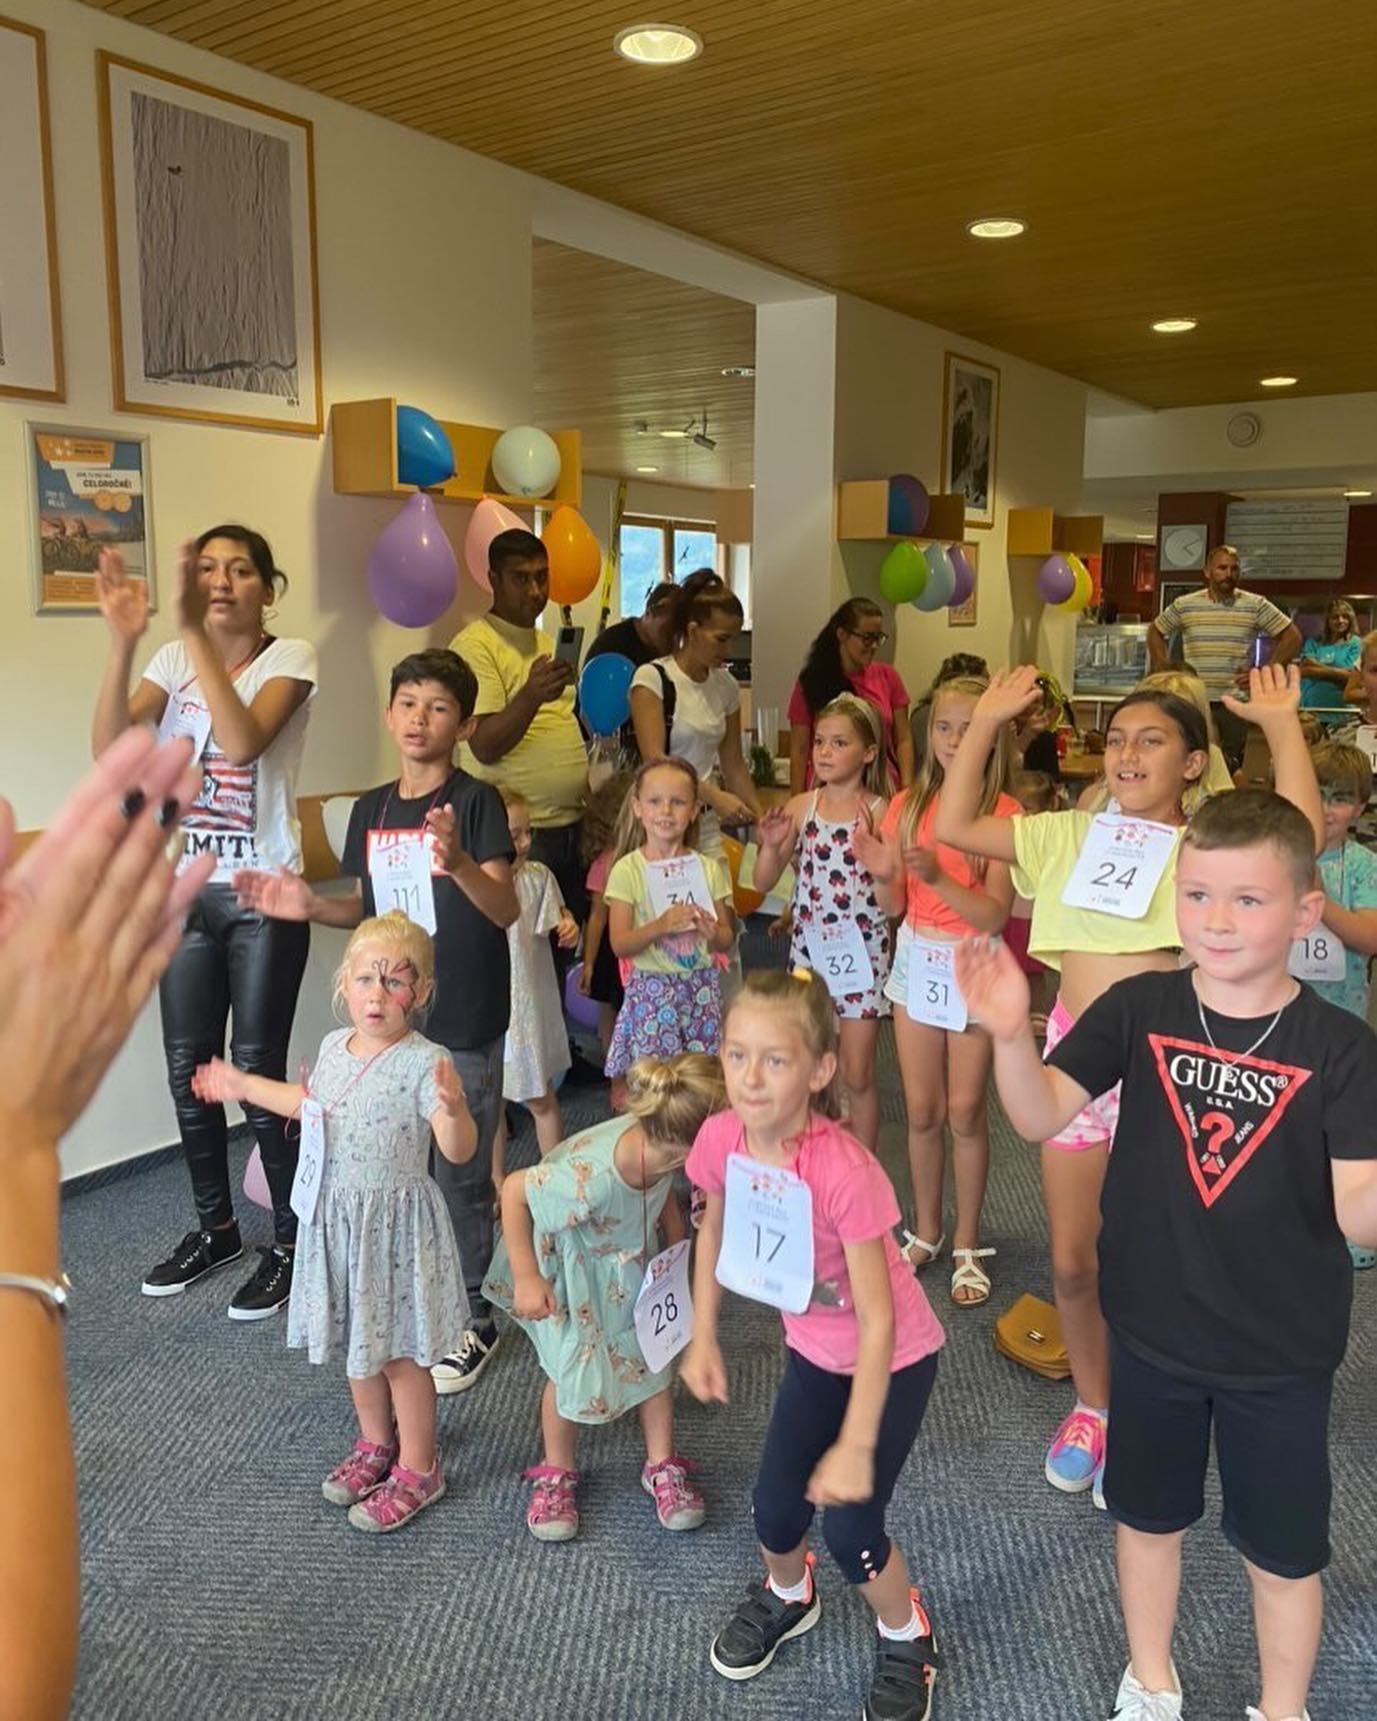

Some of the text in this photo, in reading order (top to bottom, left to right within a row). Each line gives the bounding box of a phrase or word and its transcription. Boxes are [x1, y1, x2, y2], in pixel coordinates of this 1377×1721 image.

[1090, 862, 1138, 890] 24
[1302, 938, 1328, 960] 18
[826, 954, 857, 976] 32
[926, 980, 949, 1007] 31
[1170, 1054, 1275, 1107] GUESS
[753, 1222, 787, 1262] 17
[651, 1292, 678, 1336] 28
